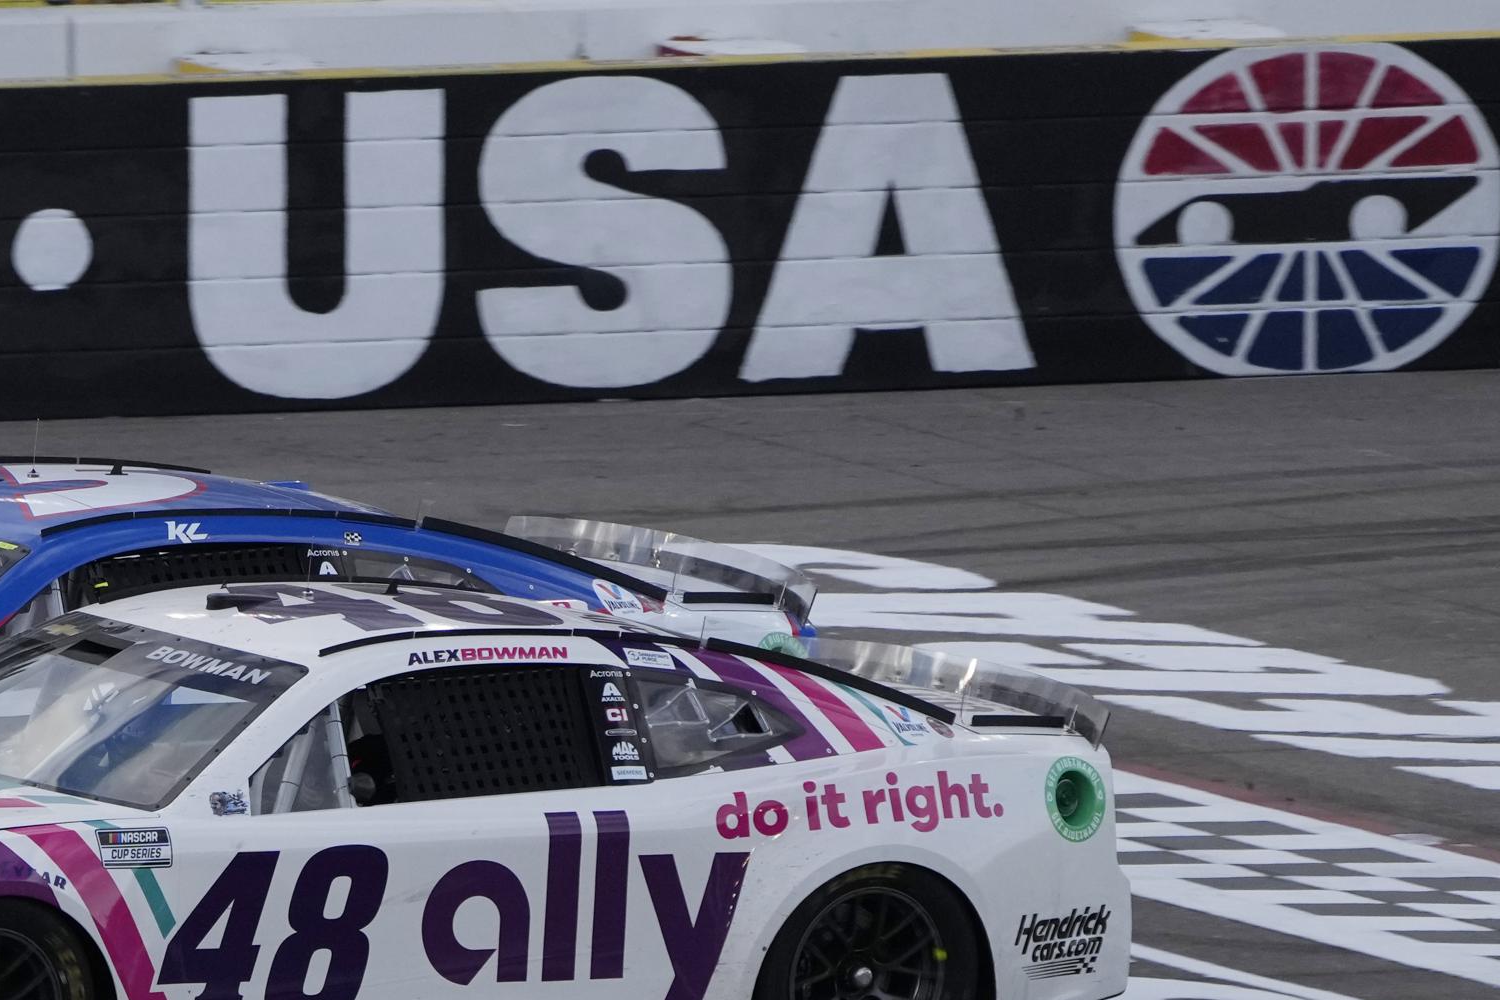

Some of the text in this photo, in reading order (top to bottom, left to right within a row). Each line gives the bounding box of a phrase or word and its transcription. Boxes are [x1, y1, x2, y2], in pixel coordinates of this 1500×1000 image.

[186, 72, 1037, 400] USA
[164, 520, 209, 544] KL
[307, 548, 340, 557] Acronis
[145, 646, 272, 685] BOWMAN
[590, 669, 624, 678] Acronis
[612, 741, 639, 756] MAC
[716, 770, 1004, 840] do it right.
[121, 831, 159, 843] NASCAR
[111, 847, 162, 860] CUP SERIES
[1014, 904, 1111, 955] Hendrick
[1031, 936, 1103, 963] cars.com
